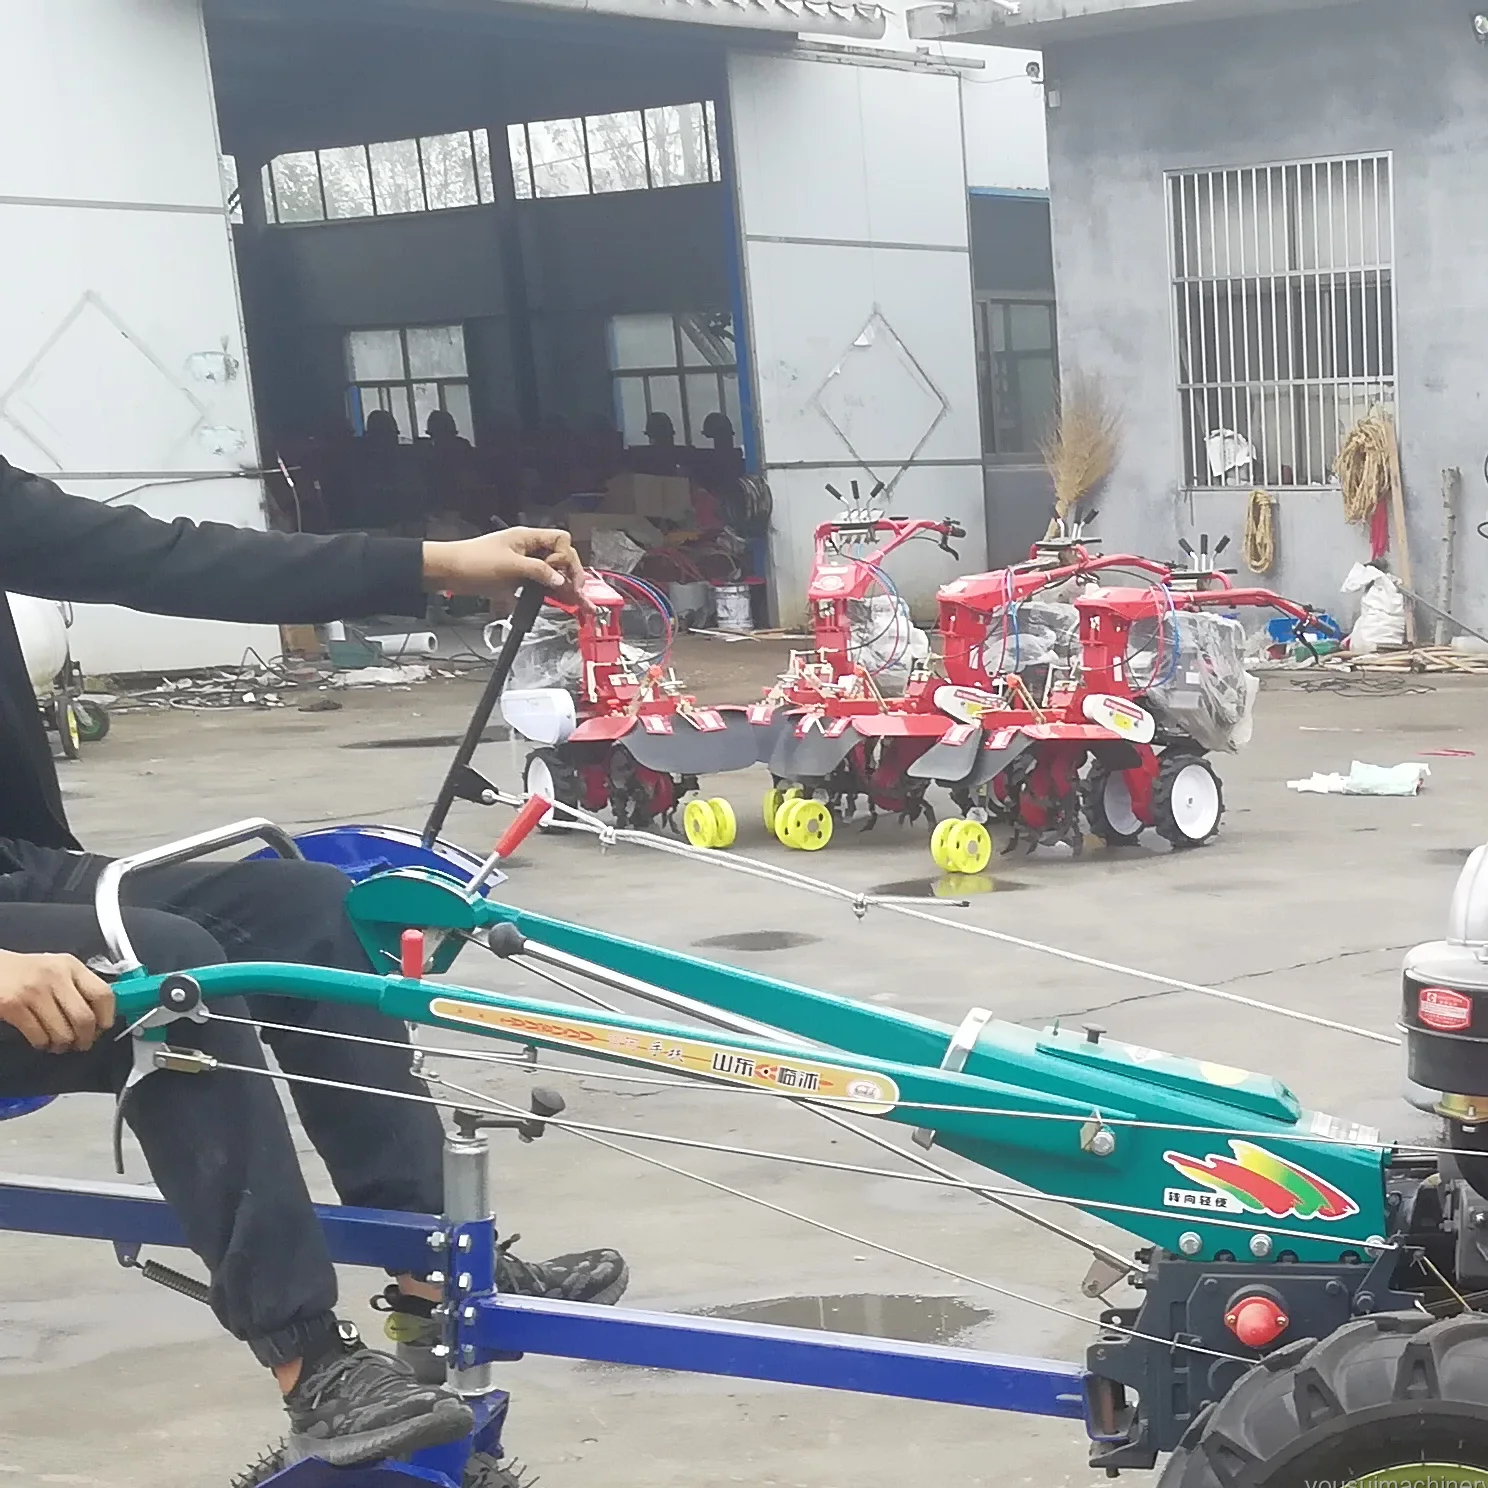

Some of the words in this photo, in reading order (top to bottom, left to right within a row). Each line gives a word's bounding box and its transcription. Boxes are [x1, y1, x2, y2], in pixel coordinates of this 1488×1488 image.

[712, 1053, 753, 1077] 山东
[1168, 1191, 1228, 1208] 转向轻便
